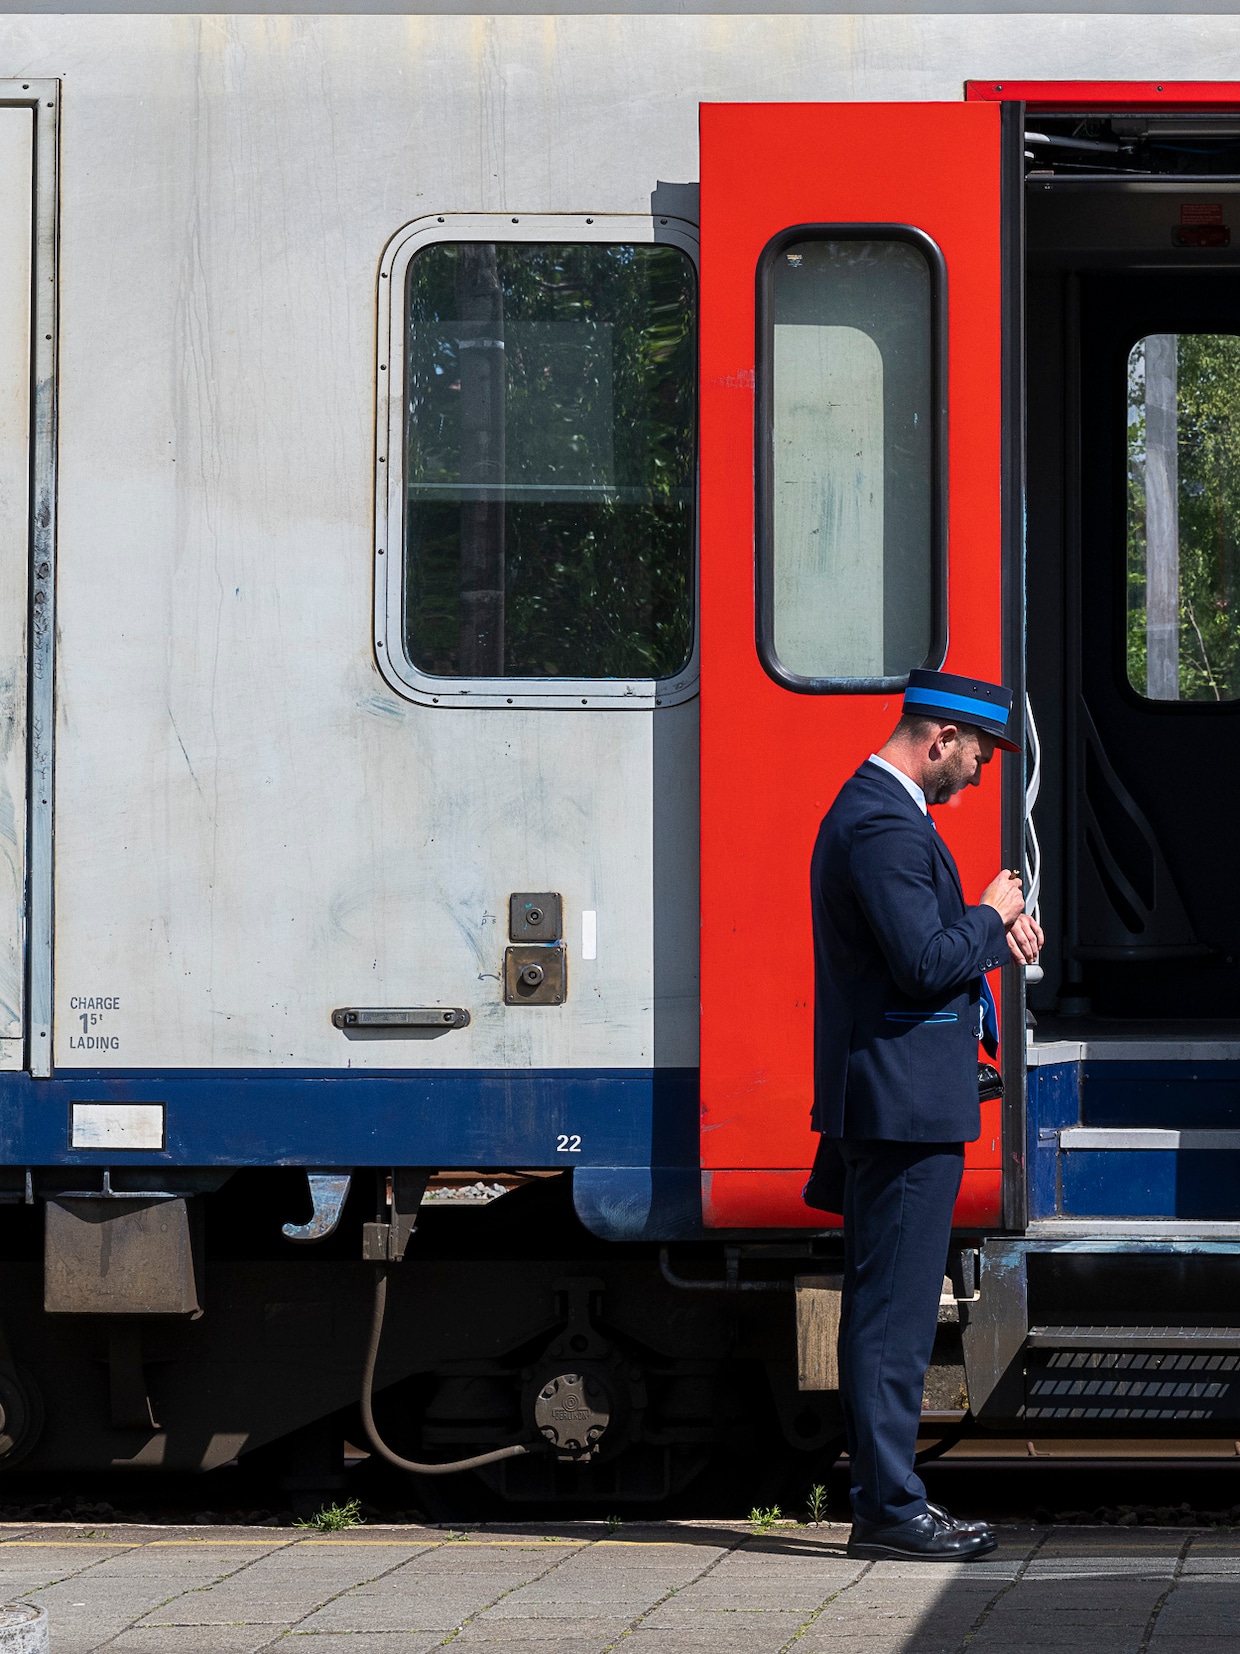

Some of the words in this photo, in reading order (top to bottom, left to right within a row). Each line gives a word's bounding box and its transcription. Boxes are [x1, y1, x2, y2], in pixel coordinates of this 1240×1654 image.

[70, 997, 120, 1010] CHARGE
[70, 1036, 120, 1050] LADING
[556, 1134, 582, 1152] 22
